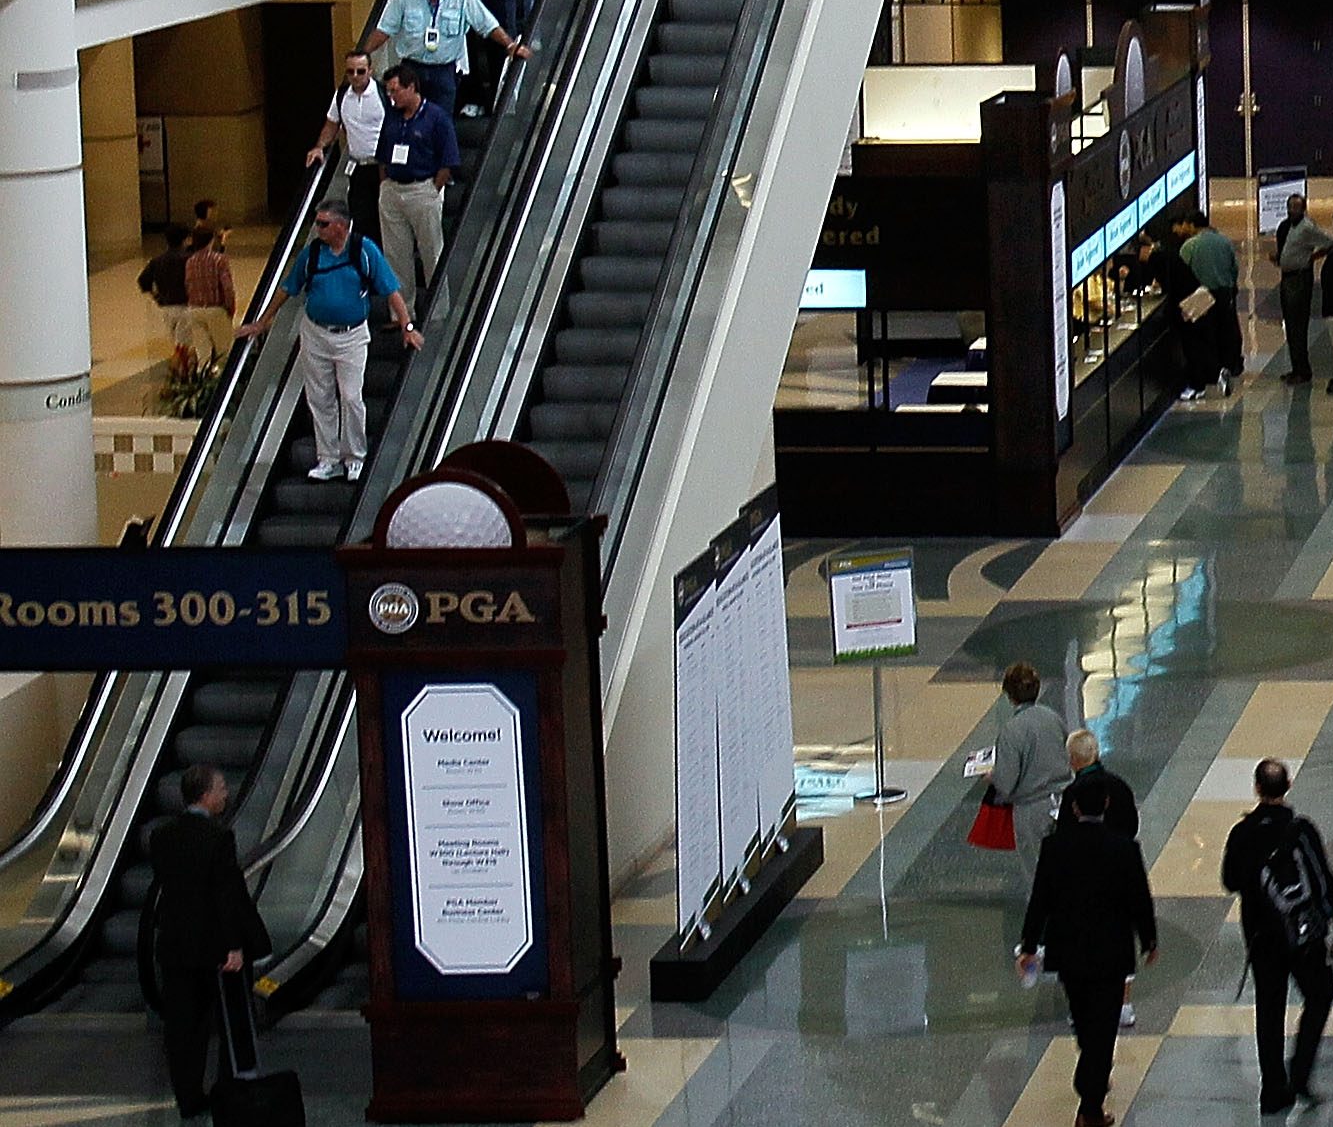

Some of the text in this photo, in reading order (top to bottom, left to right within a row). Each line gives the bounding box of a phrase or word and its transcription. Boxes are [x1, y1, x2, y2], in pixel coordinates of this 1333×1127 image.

[0, 588, 332, 627] Rooms 300-315
[425, 590, 537, 624] PGA
[422, 727, 502, 744] Welcome!
